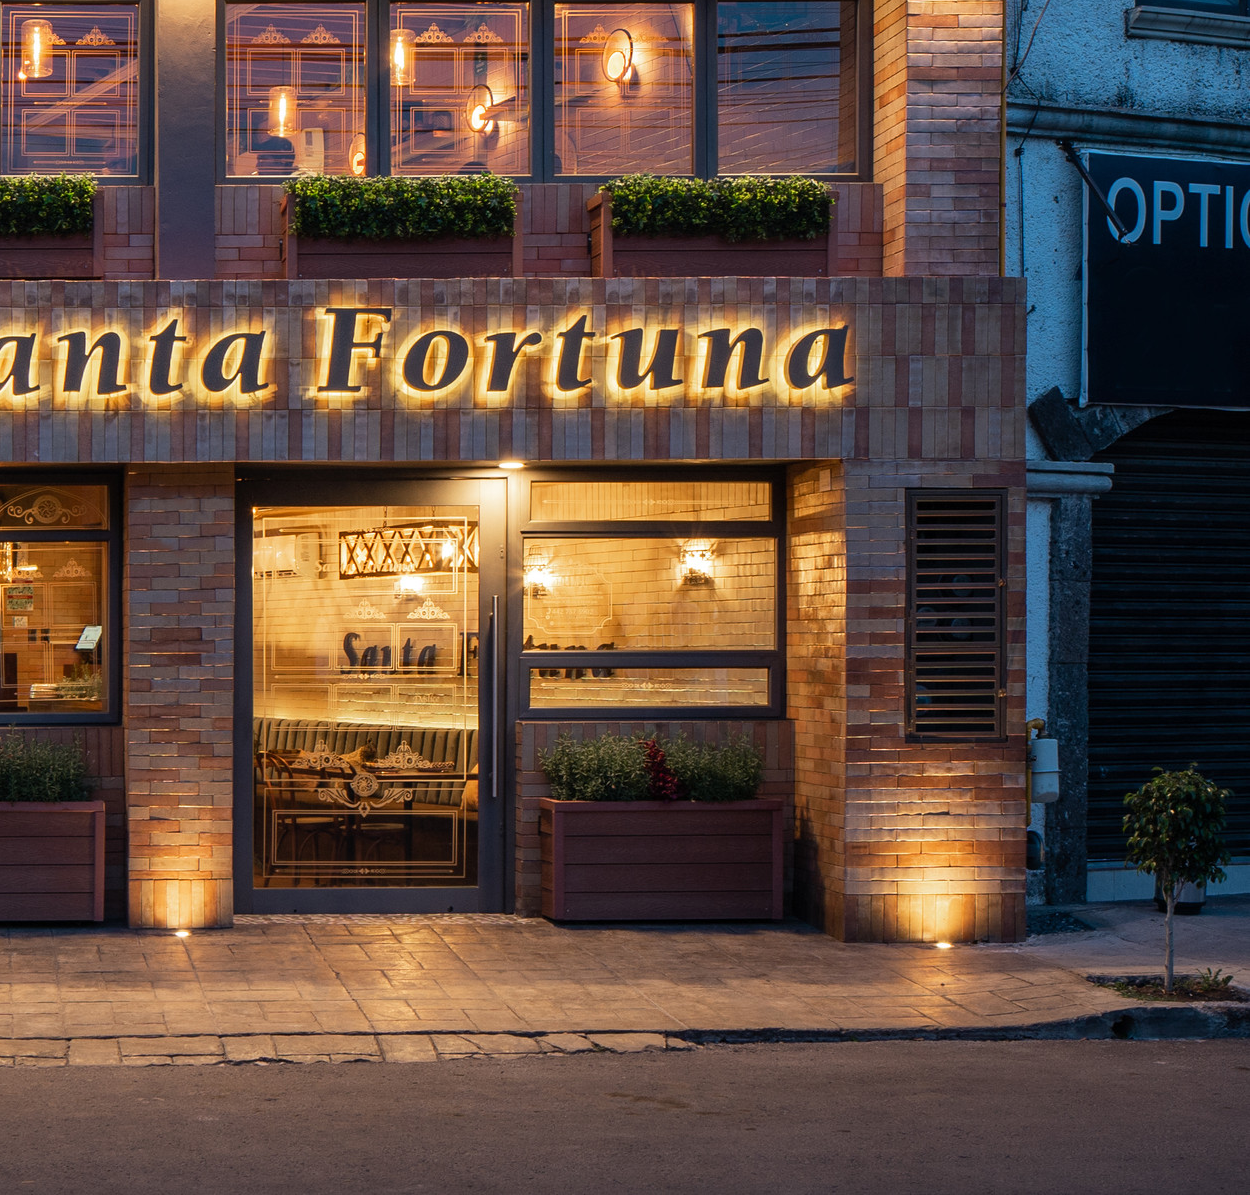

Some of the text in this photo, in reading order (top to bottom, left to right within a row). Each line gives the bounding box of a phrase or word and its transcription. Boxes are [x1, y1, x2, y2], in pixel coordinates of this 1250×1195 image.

[1107, 177, 1250, 249] OPTI
[316, 306, 855, 392] Fortuna
[340, 632, 436, 675] Santa
